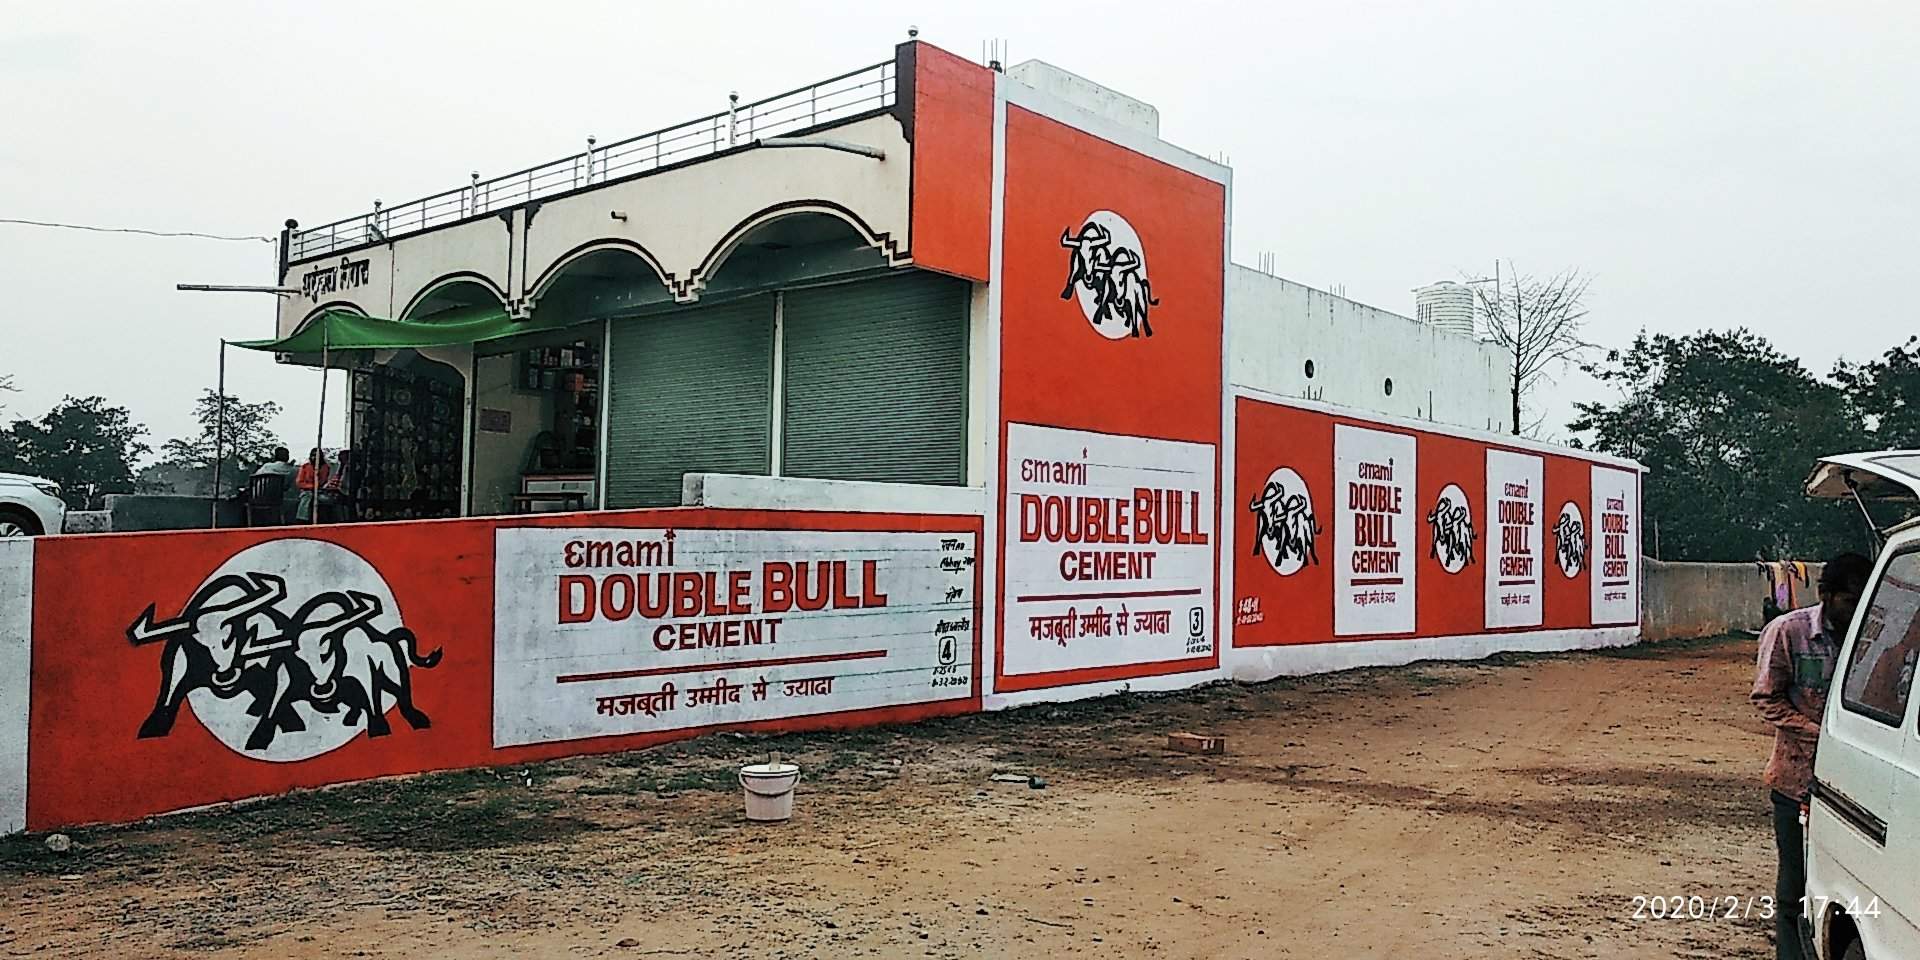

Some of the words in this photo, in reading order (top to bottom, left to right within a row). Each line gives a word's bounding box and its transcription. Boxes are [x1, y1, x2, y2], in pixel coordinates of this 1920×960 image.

[1021, 447, 1087, 486] emami
[1358, 456, 1394, 482] emami
[1348, 481, 1402, 515] DOUBLE
[1498, 499, 1535, 525] DOUBLE
[1019, 493, 1130, 544] DOUBLE
[1133, 487, 1209, 545] BULL
[1354, 512, 1397, 548] BULL
[1601, 512, 1629, 535] DOUBLE
[564, 528, 675, 568] emami
[1501, 525, 1531, 555] BULL
[1604, 534, 1627, 559] BULL
[1059, 550, 1157, 581] CEMENT
[1351, 550, 1401, 574] CEMENT
[1499, 556, 1534, 577] CEMENT
[1602, 560, 1629, 577] CEMENT
[557, 570, 752, 625] DOUBLE
[761, 559, 889, 614] BULL
[652, 617, 783, 651] CEMENT
[1028, 606, 1078, 648] मजबूती
[1078, 605, 1113, 638] उम्मीद
[1115, 602, 1130, 636] से
[1133, 609, 1172, 635] ज्यादा
[1192, 611, 1200, 631] 3
[941, 639, 952, 661] 4
[595, 681, 679, 718] मजबूती
[684, 676, 744, 708] उम्मीद
[751, 675, 769, 701] से
[781, 675, 836, 698] ज्यादा
